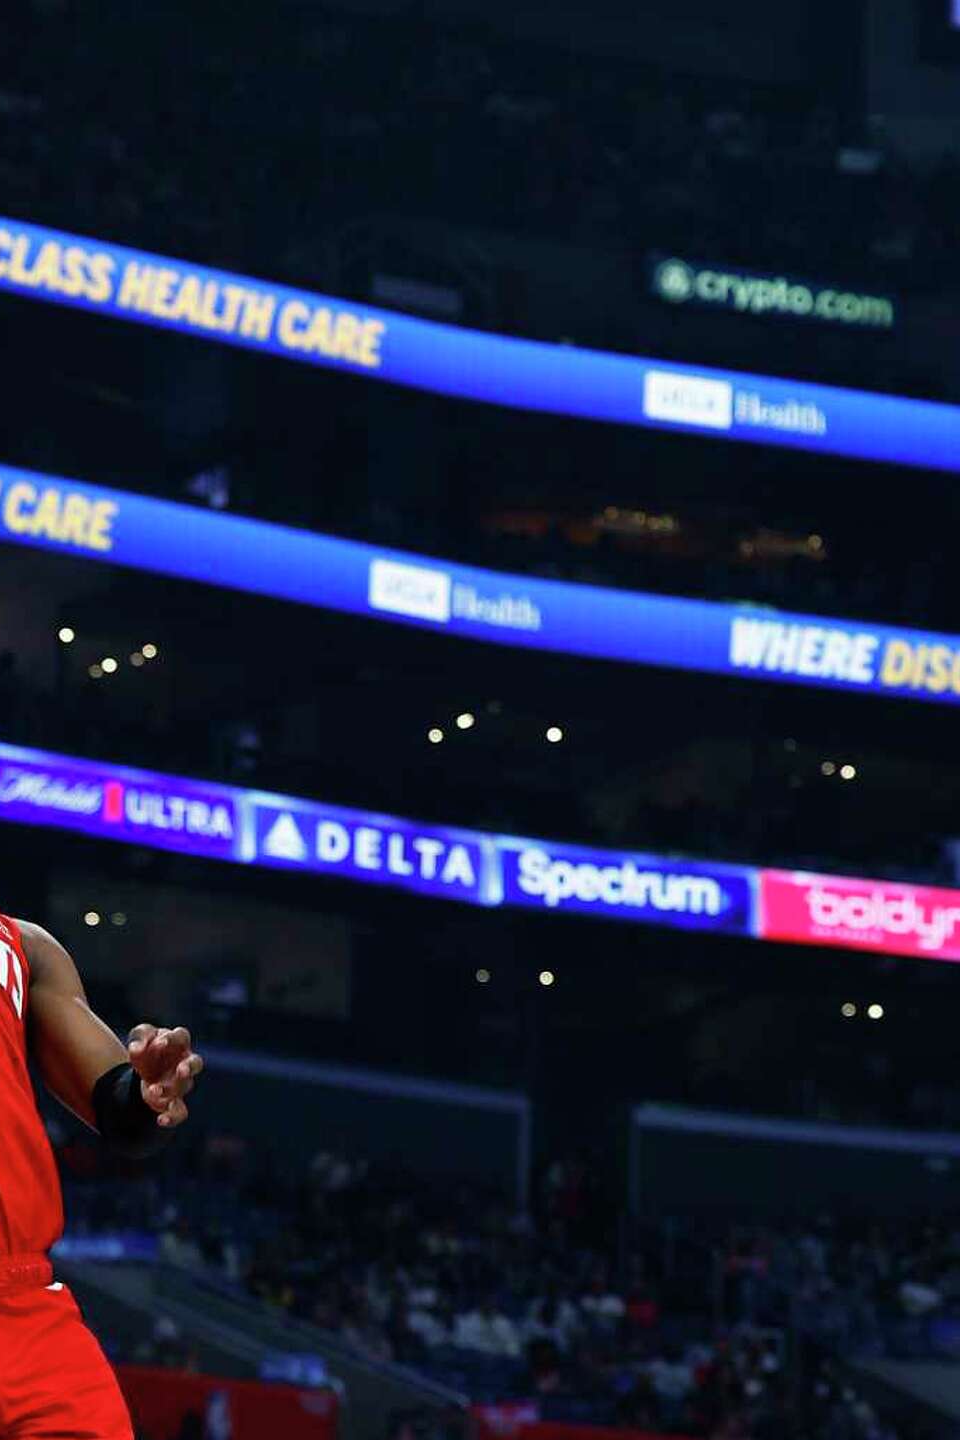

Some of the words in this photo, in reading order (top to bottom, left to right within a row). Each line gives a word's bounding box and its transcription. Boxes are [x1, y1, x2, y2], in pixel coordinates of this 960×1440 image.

[116, 258, 276, 342] HEALTH
[277, 300, 386, 368] CARE
[3, 481, 119, 552] CARE
[730, 615, 878, 684] WHERE
[124, 788, 234, 840] ULTRA
[315, 820, 475, 887] DELTA
[517, 848, 724, 917] Spectrum
